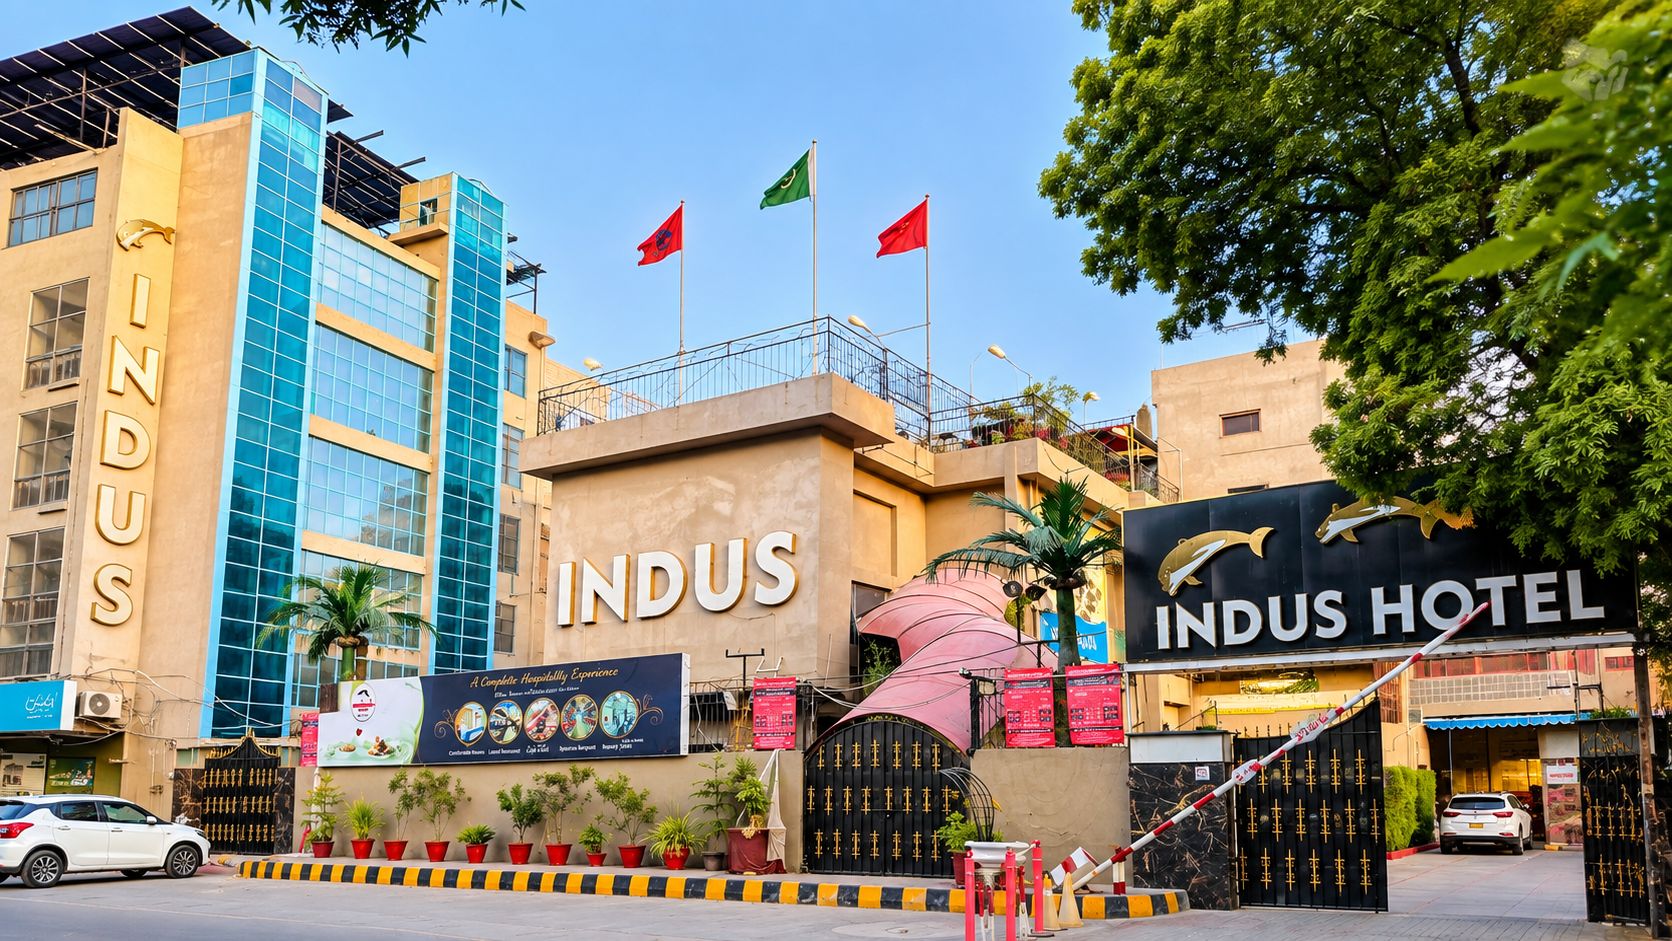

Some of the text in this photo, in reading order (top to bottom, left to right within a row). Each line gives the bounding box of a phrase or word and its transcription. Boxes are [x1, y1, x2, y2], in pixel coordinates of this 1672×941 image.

[91, 273, 160, 627] INDUS
[557, 530, 799, 627] INDUS
[1156, 569, 1605, 650] INDUS HOTEL
